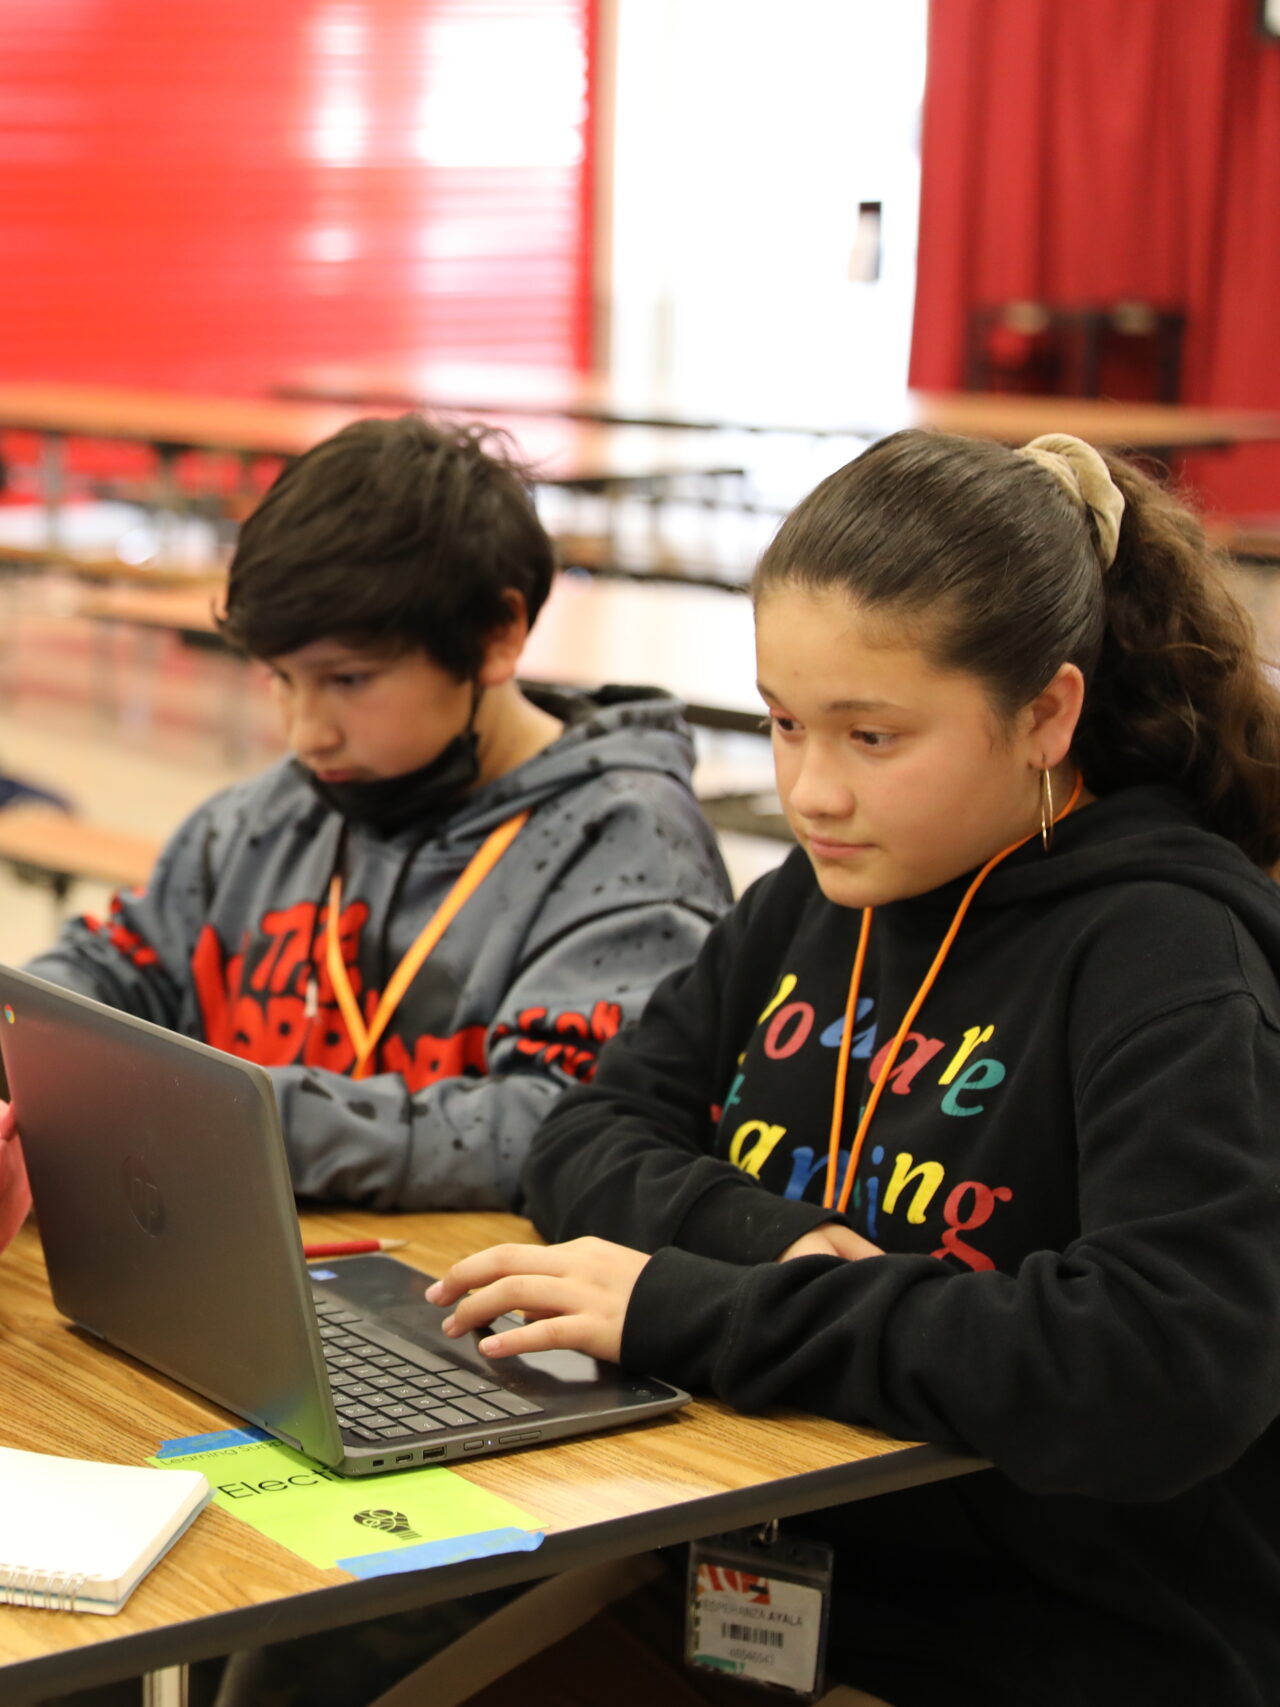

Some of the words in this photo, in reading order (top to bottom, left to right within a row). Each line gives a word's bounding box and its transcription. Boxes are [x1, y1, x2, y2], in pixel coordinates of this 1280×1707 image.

[869, 1024, 1006, 1117] are
[160, 1445, 239, 1466] Learning
[768, 1610, 803, 1627] AYALA
